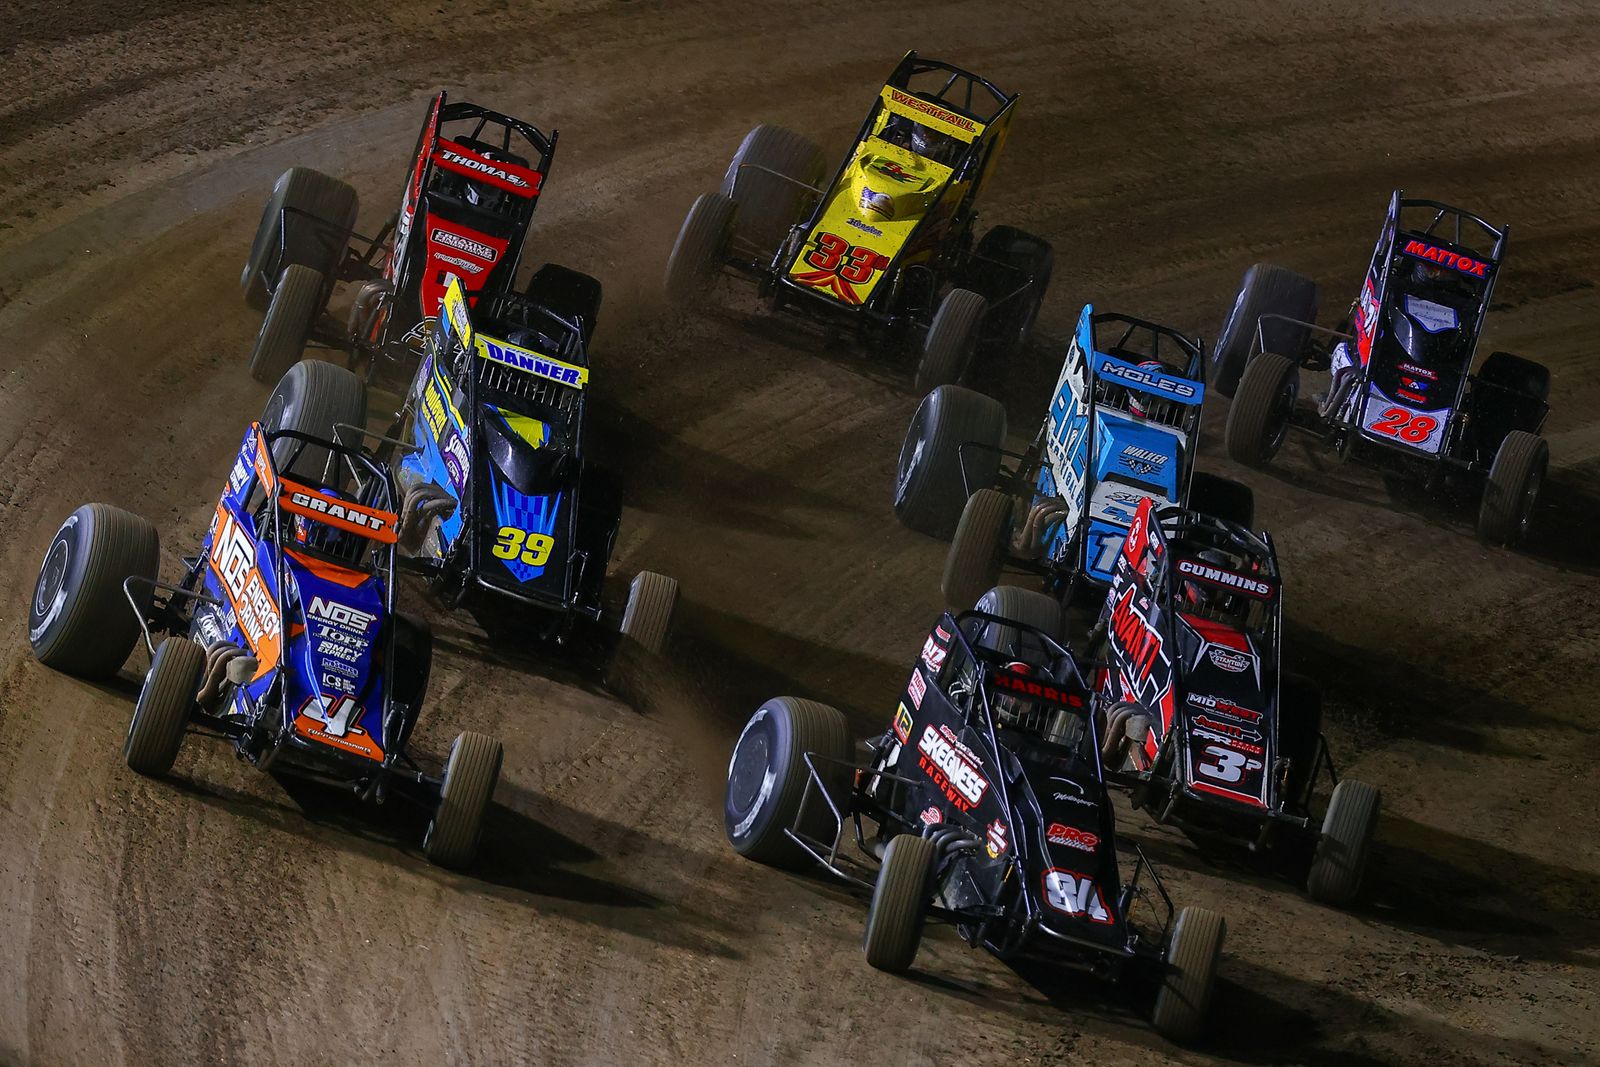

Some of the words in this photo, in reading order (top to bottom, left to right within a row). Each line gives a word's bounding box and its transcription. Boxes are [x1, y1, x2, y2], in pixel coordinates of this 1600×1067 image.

[892, 90, 976, 132] WESTFALL
[442, 150, 520, 184] THOMAS
[1404, 241, 1488, 276] MATTOX
[482, 340, 580, 388] DANNER
[1102, 361, 1195, 397] MOLES
[1403, 363, 1433, 377] MATTOX
[1369, 407, 1438, 444] 28
[1124, 445, 1170, 466] WALKER
[291, 491, 386, 531] GRANT
[212, 514, 255, 603] NOS
[491, 526, 556, 567] 39
[1178, 561, 1270, 595] CUMMINS
[239, 591, 264, 650] DRINK
[245, 573, 281, 641] ENERGY
[306, 613, 339, 627] ENERGY
[338, 623, 365, 636] DRINK
[308, 595, 378, 632] NOS
[316, 623, 370, 649] TOPP
[1111, 588, 1161, 681] AVANTI
[317, 647, 357, 663] EXPRESS
[322, 672, 343, 688] ICS
[993, 673, 1084, 709] HARRIS
[918, 725, 988, 804] SKEGNESS
[918, 756, 969, 813] RACEWAY
[1047, 822, 1099, 847] PRG
